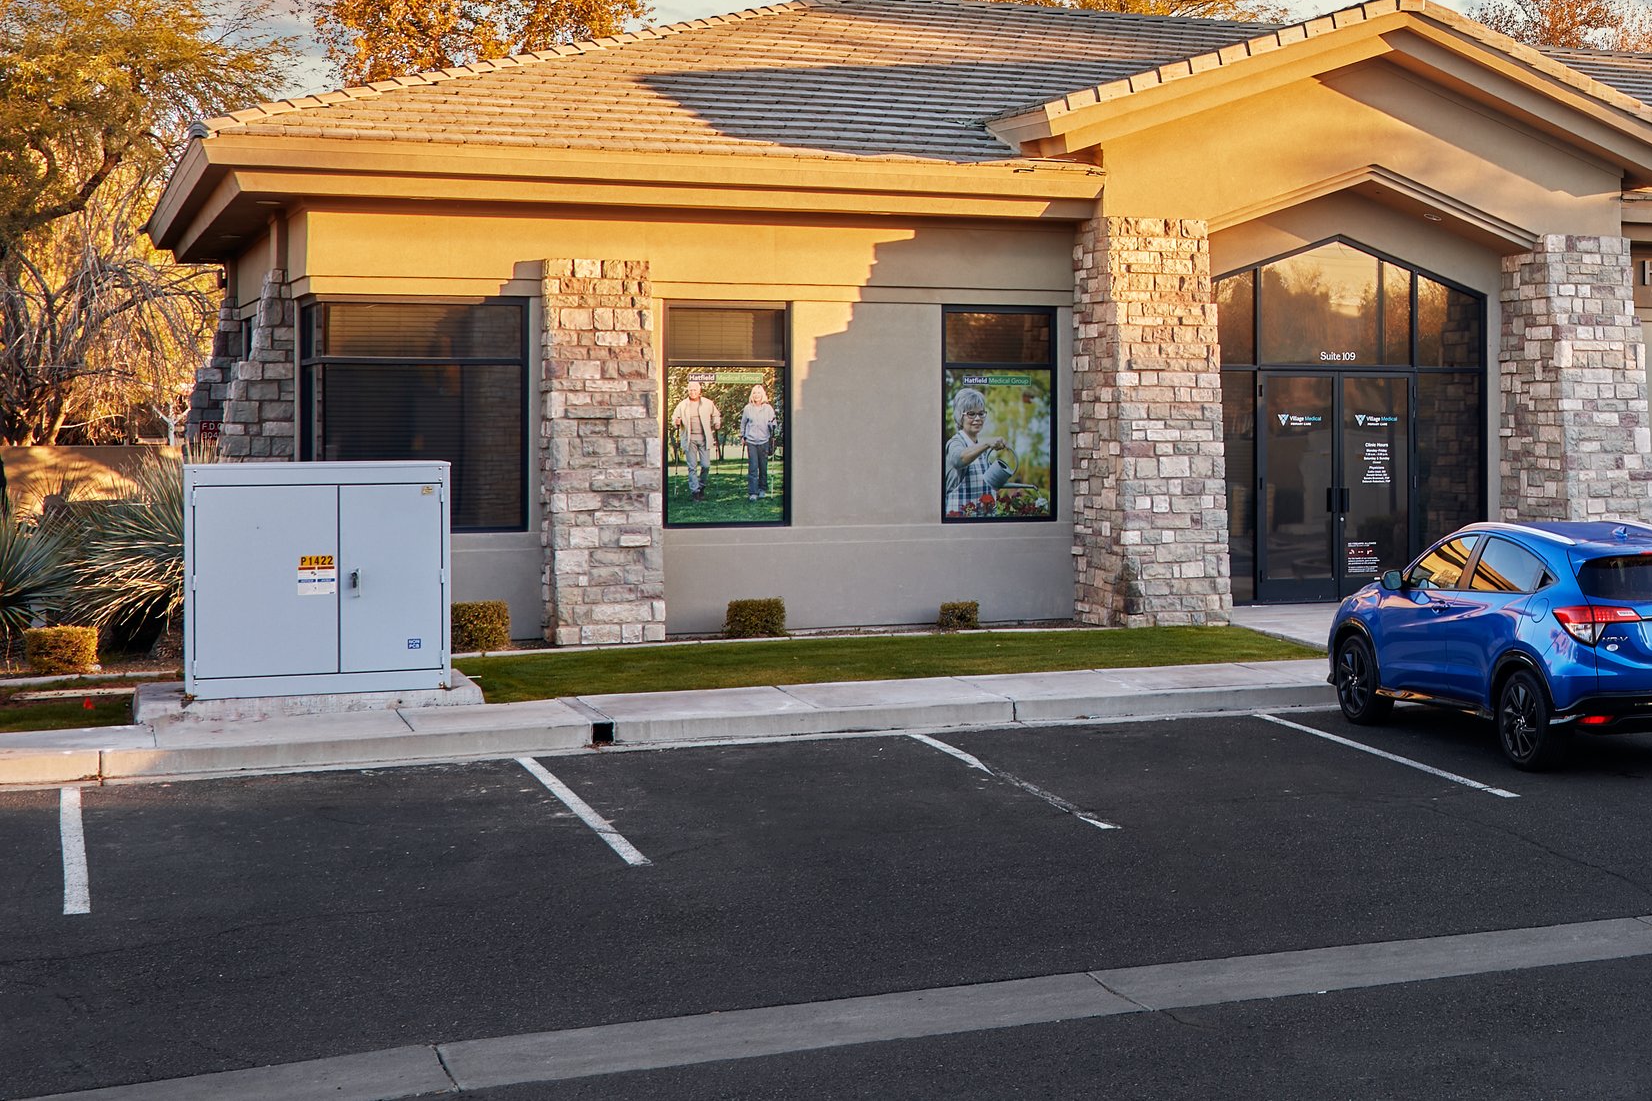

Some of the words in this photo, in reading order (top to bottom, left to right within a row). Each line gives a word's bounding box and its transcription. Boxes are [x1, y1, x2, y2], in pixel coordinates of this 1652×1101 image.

[1320, 351, 1341, 361] Suite
[1342, 351, 1356, 361] 109
[742, 374, 761, 382] Group
[1011, 377, 1029, 385] Group
[300, 555, 334, 566] P1422
